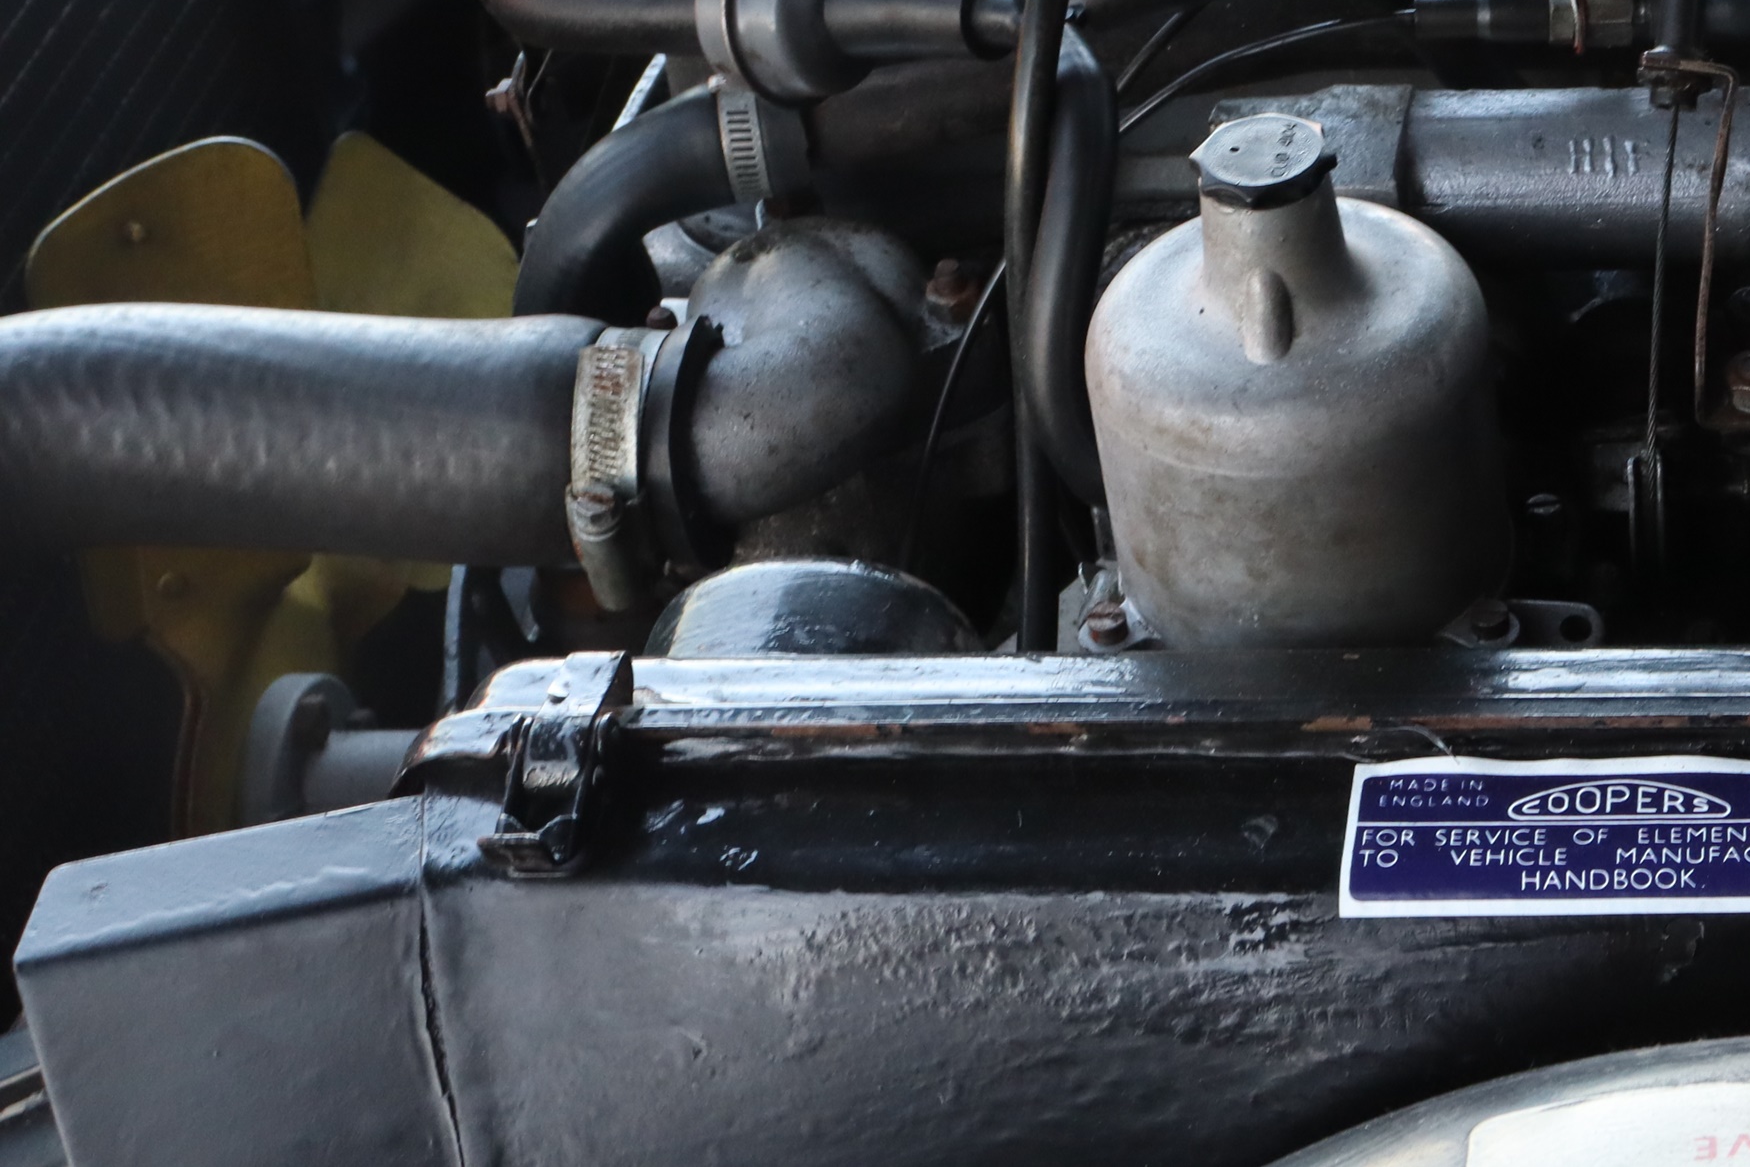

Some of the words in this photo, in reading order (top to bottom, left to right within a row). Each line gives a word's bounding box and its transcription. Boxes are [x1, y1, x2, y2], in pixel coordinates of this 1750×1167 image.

[1389, 778, 1449, 791] MADE
[1461, 779, 1484, 791] IN
[1379, 794, 1490, 808] ENGLAND
[1521, 785, 1710, 815] COOPERS
[1361, 828, 1416, 847] FOR
[1434, 827, 1548, 847] SERVICE
[1572, 827, 1609, 846] OF
[1358, 848, 1399, 868] TO
[1450, 847, 1568, 867] VEHICLE
